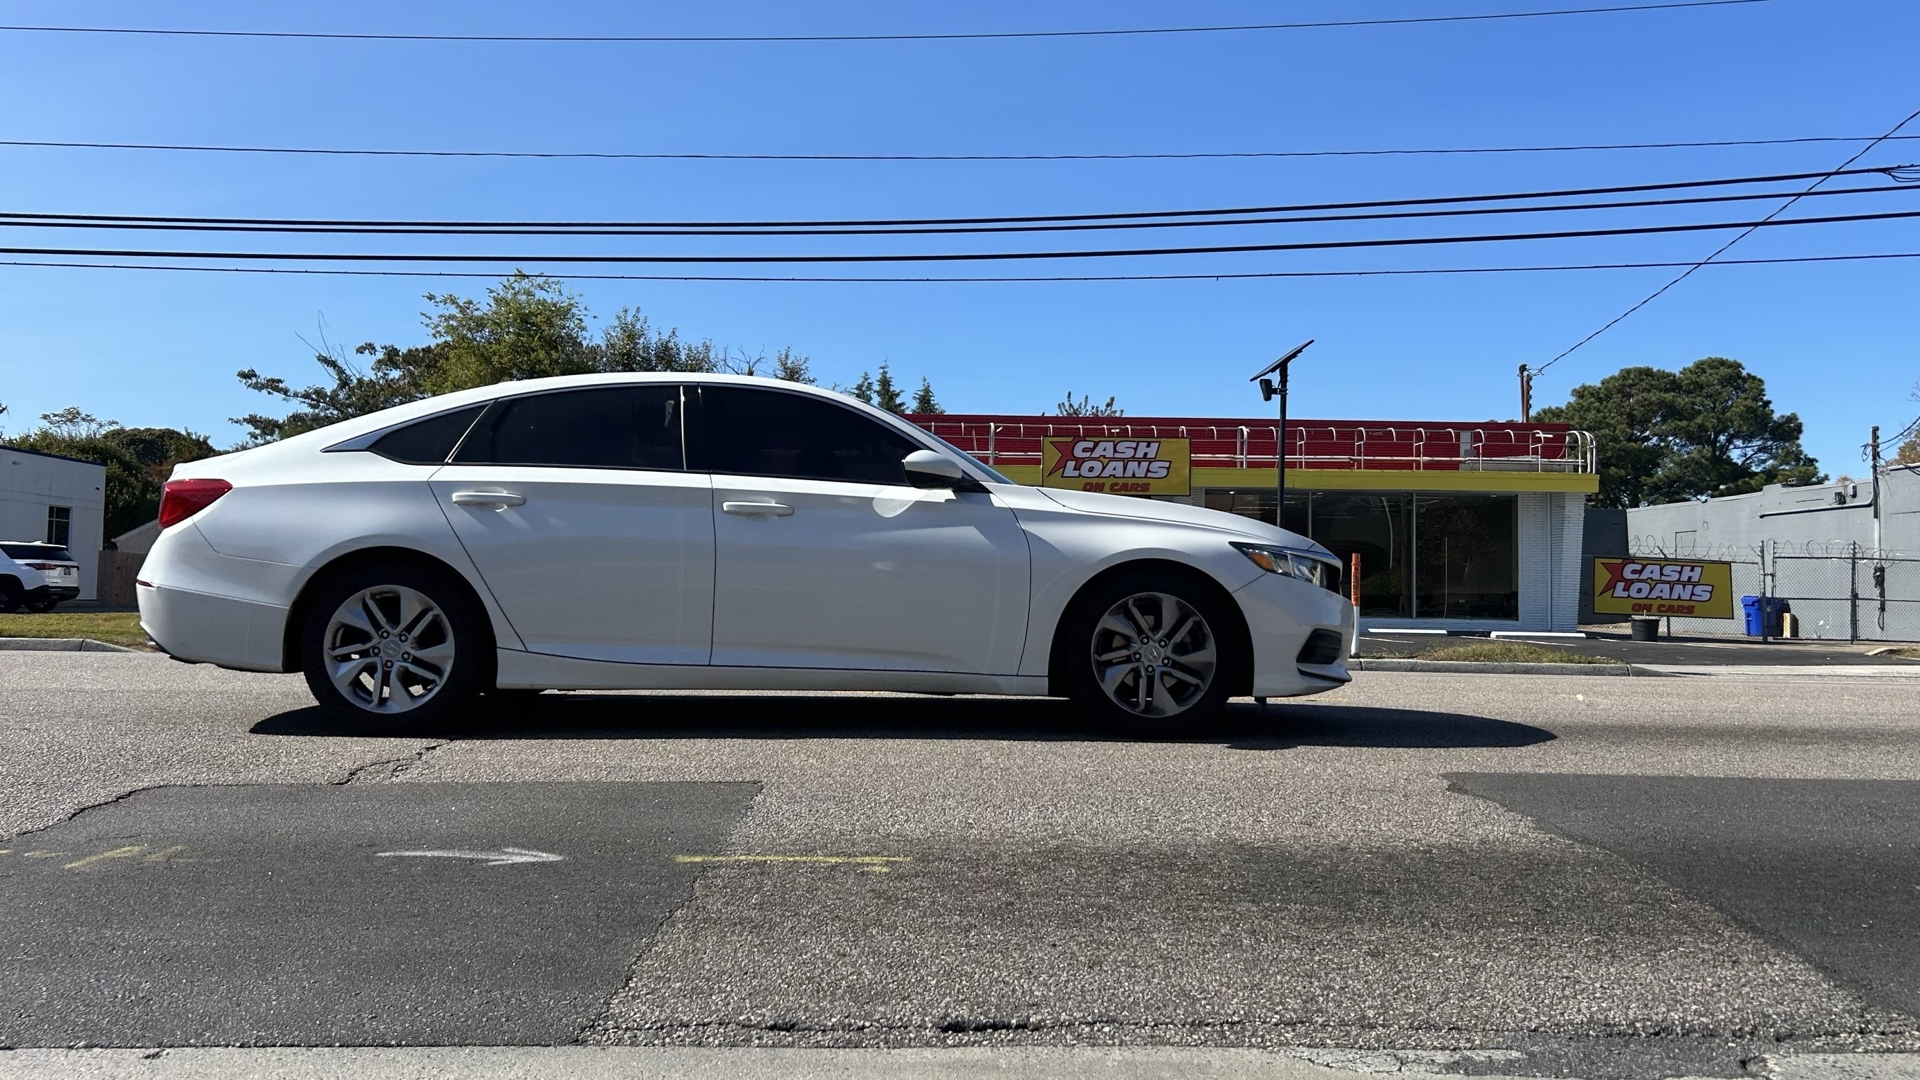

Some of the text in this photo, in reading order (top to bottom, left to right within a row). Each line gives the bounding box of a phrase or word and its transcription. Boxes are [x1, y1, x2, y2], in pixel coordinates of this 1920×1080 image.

[1072, 440, 1160, 459] CASH
[1061, 460, 1172, 478] LOANS
[1083, 482, 1151, 493] ON CARS
[1621, 563, 1703, 582] CASH
[1612, 581, 1714, 602] LOANS
[1631, 603, 1695, 614] ON CARS
